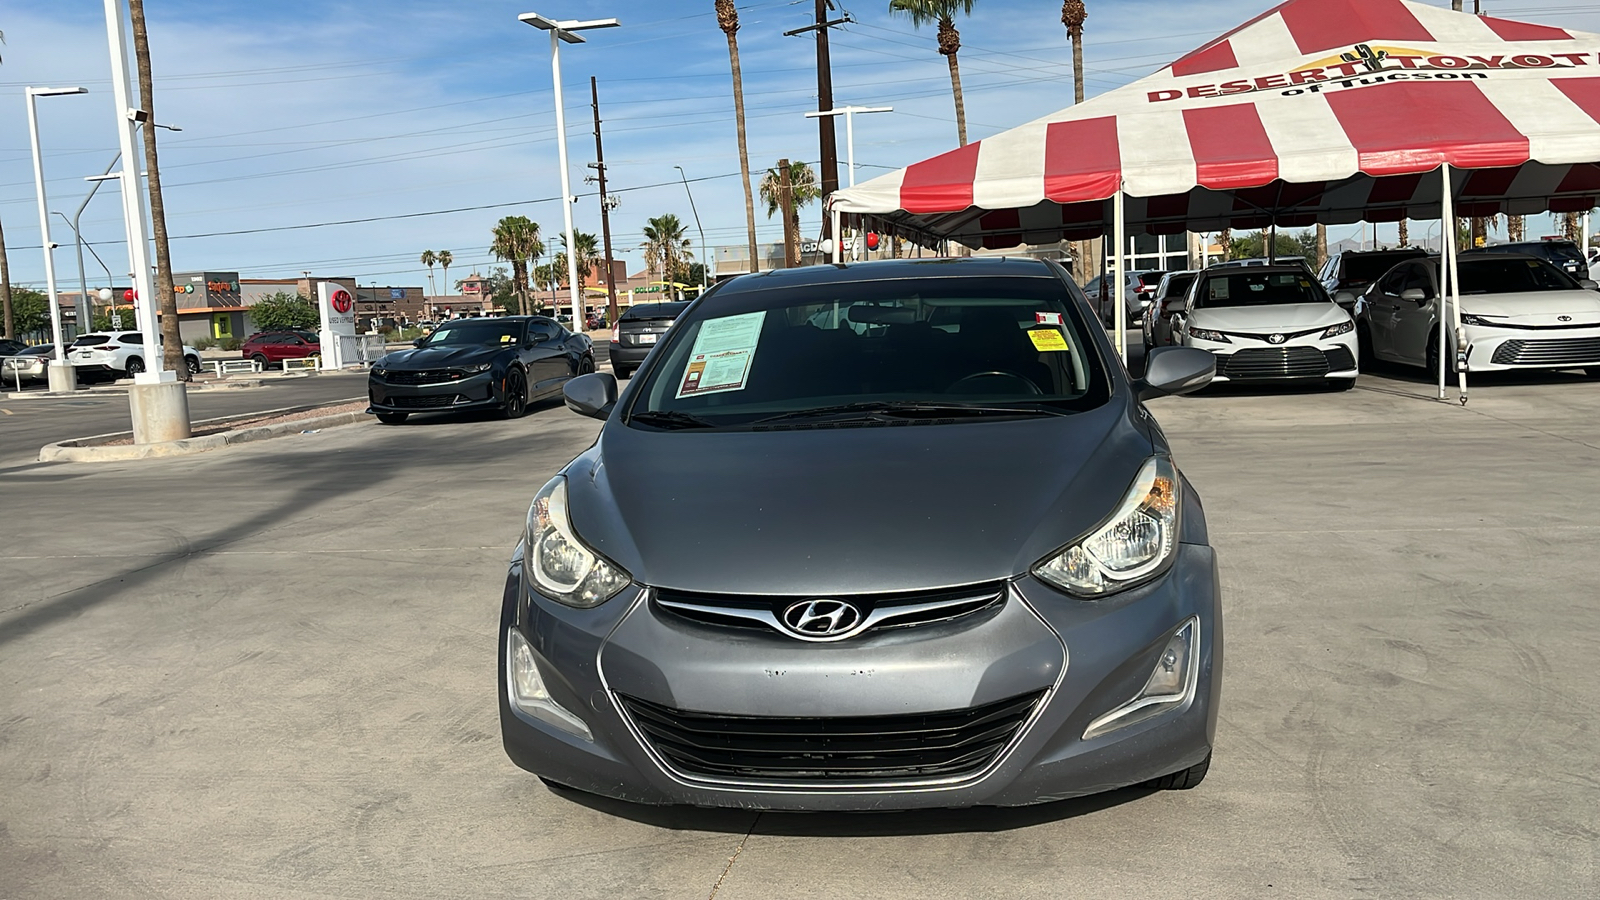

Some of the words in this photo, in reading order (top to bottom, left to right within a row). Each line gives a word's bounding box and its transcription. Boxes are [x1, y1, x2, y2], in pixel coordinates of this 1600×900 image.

[1147, 60, 1364, 103] DESERT
[1386, 53, 1600, 69] TOYOT
[1281, 83, 1323, 97] of
[1331, 72, 1489, 88] Tucson
[634, 286, 660, 294] DOLLAR
